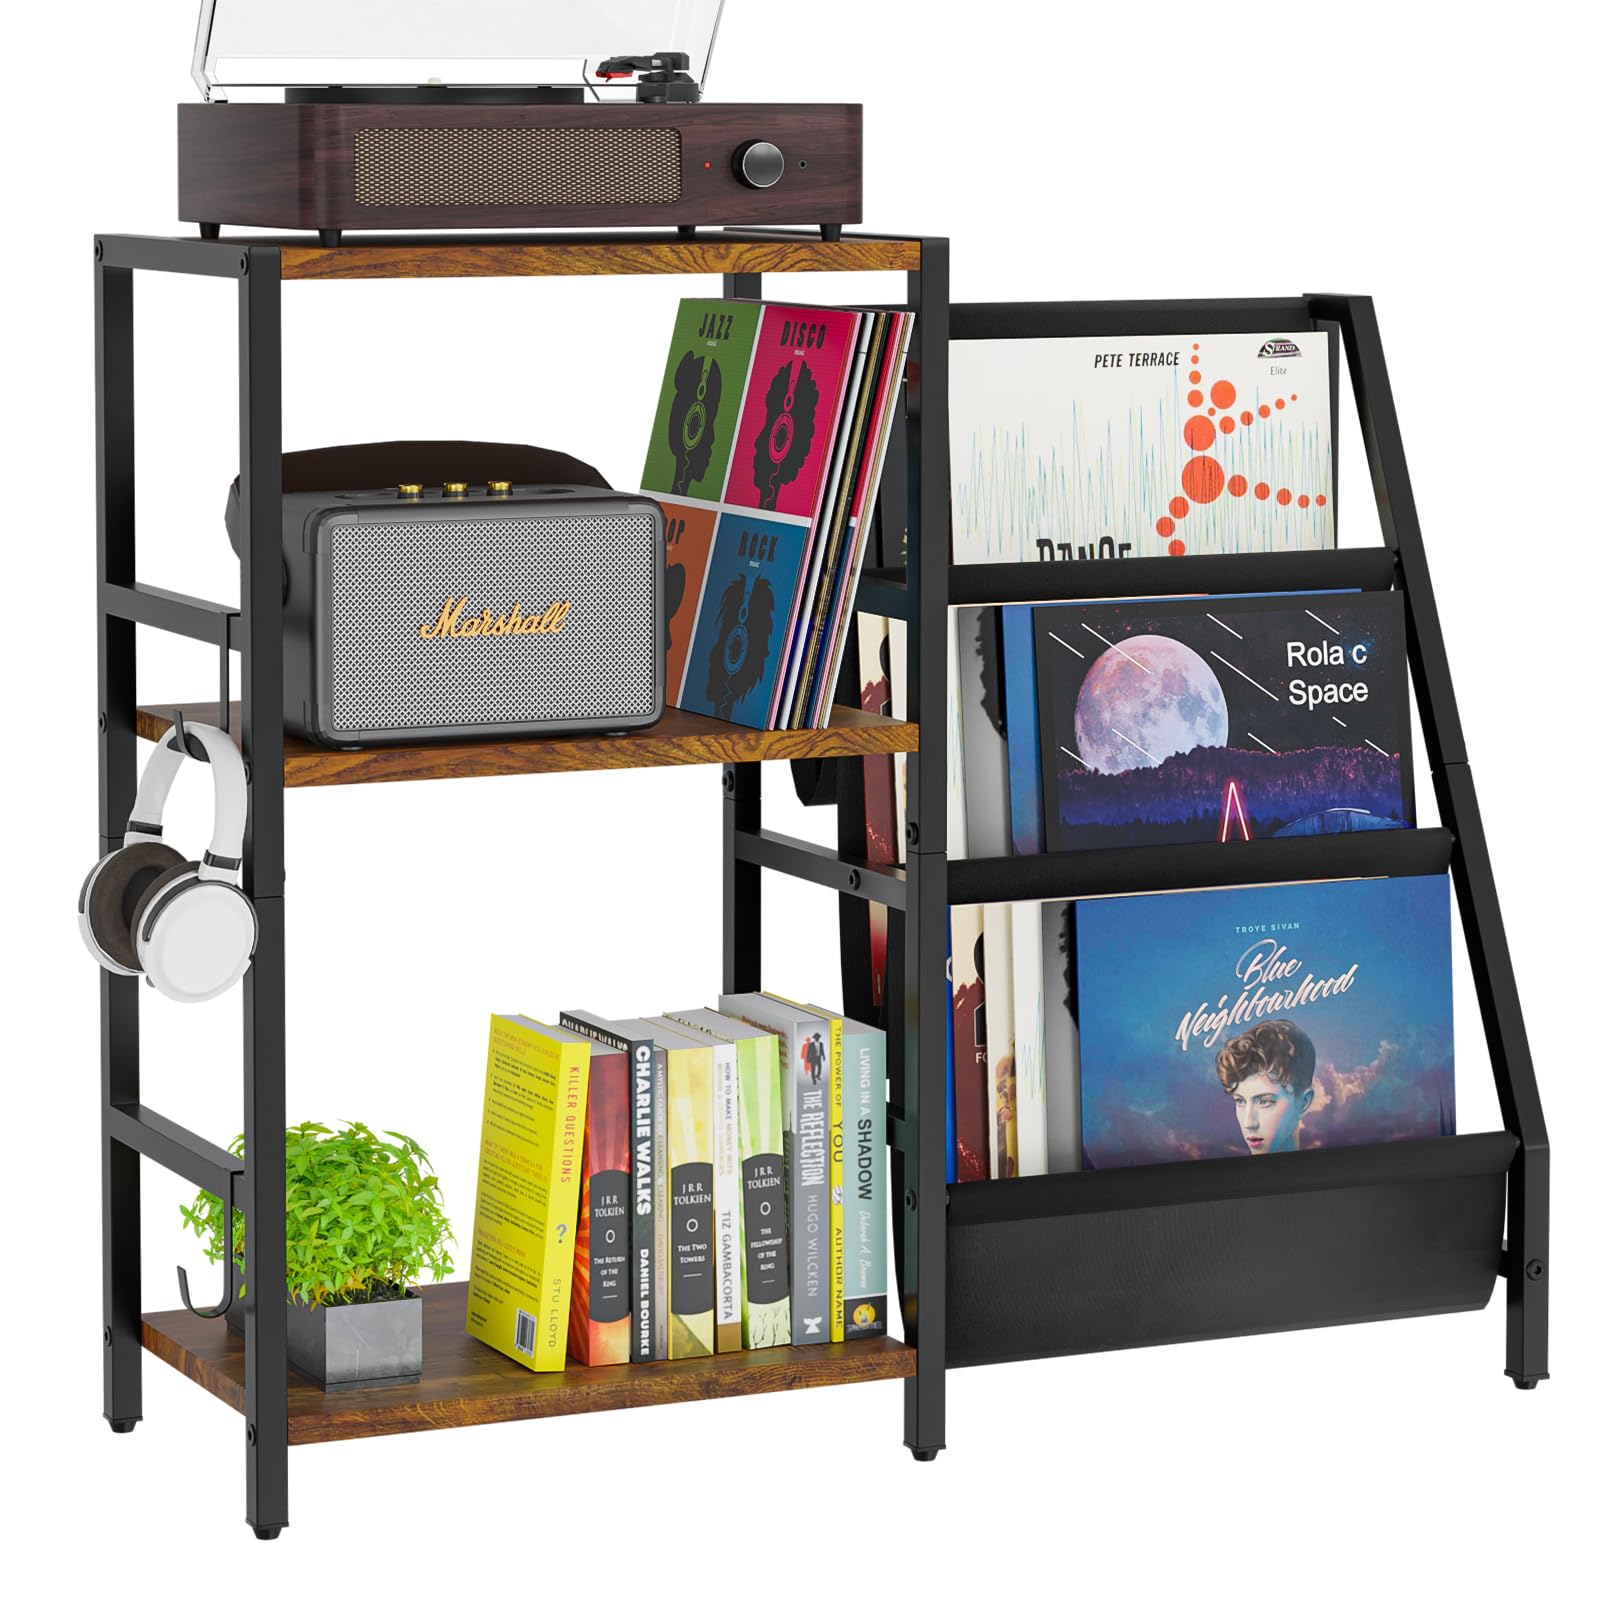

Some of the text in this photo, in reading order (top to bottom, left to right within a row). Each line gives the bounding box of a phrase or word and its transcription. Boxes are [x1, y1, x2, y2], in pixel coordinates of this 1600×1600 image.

[699, 313, 734, 340] JAZZ
[780, 320, 826, 349] DISCO
[1094, 351, 1180, 368] PETE TERRACE
[1270, 366, 1287, 376] Elite
[664, 518, 686, 544] OP
[739, 531, 778, 562] ROCK
[419, 595, 571, 639] Marshall
[1287, 640, 1367, 667] Rola c
[1289, 679, 1369, 711] Space
[1235, 922, 1300, 933] TROYE SIVAN
[1235, 938, 1302, 989] Blue
[1175, 964, 1359, 1051] Neighbourhood
[567, 1067, 580, 1108] KILLER
[725, 1084, 732, 1095] TO
[860, 1047, 871, 1116] LIVING IN A
[725, 1098, 733, 1120] MAKE
[835, 1093, 842, 1107] OF
[635, 1045, 652, 1216] CHARLIE WALKS
[799, 1089, 825, 1186] THE REFLECTION
[832, 1120, 843, 1163] YOU
[560, 1115, 577, 1183] QUESTIONS
[857, 1118, 873, 1200] SHADOW
[747, 1176, 781, 1190] TOLKIEN
[594, 1206, 624, 1218] TOLKIEN
[673, 1193, 712, 1206] TOLKIEN
[679, 1255, 706, 1264] TOWERS
[692, 1243, 708, 1251] TWO
[807, 1194, 819, 1297] HUGO WILCKEN
[835, 1227, 843, 1287] AUTHOR
[721, 1211, 733, 1320] TIZ GAMBACORTA
[548, 1278, 562, 1348] STU LLOYD
[639, 1248, 650, 1356] DANIEL BOURKE
